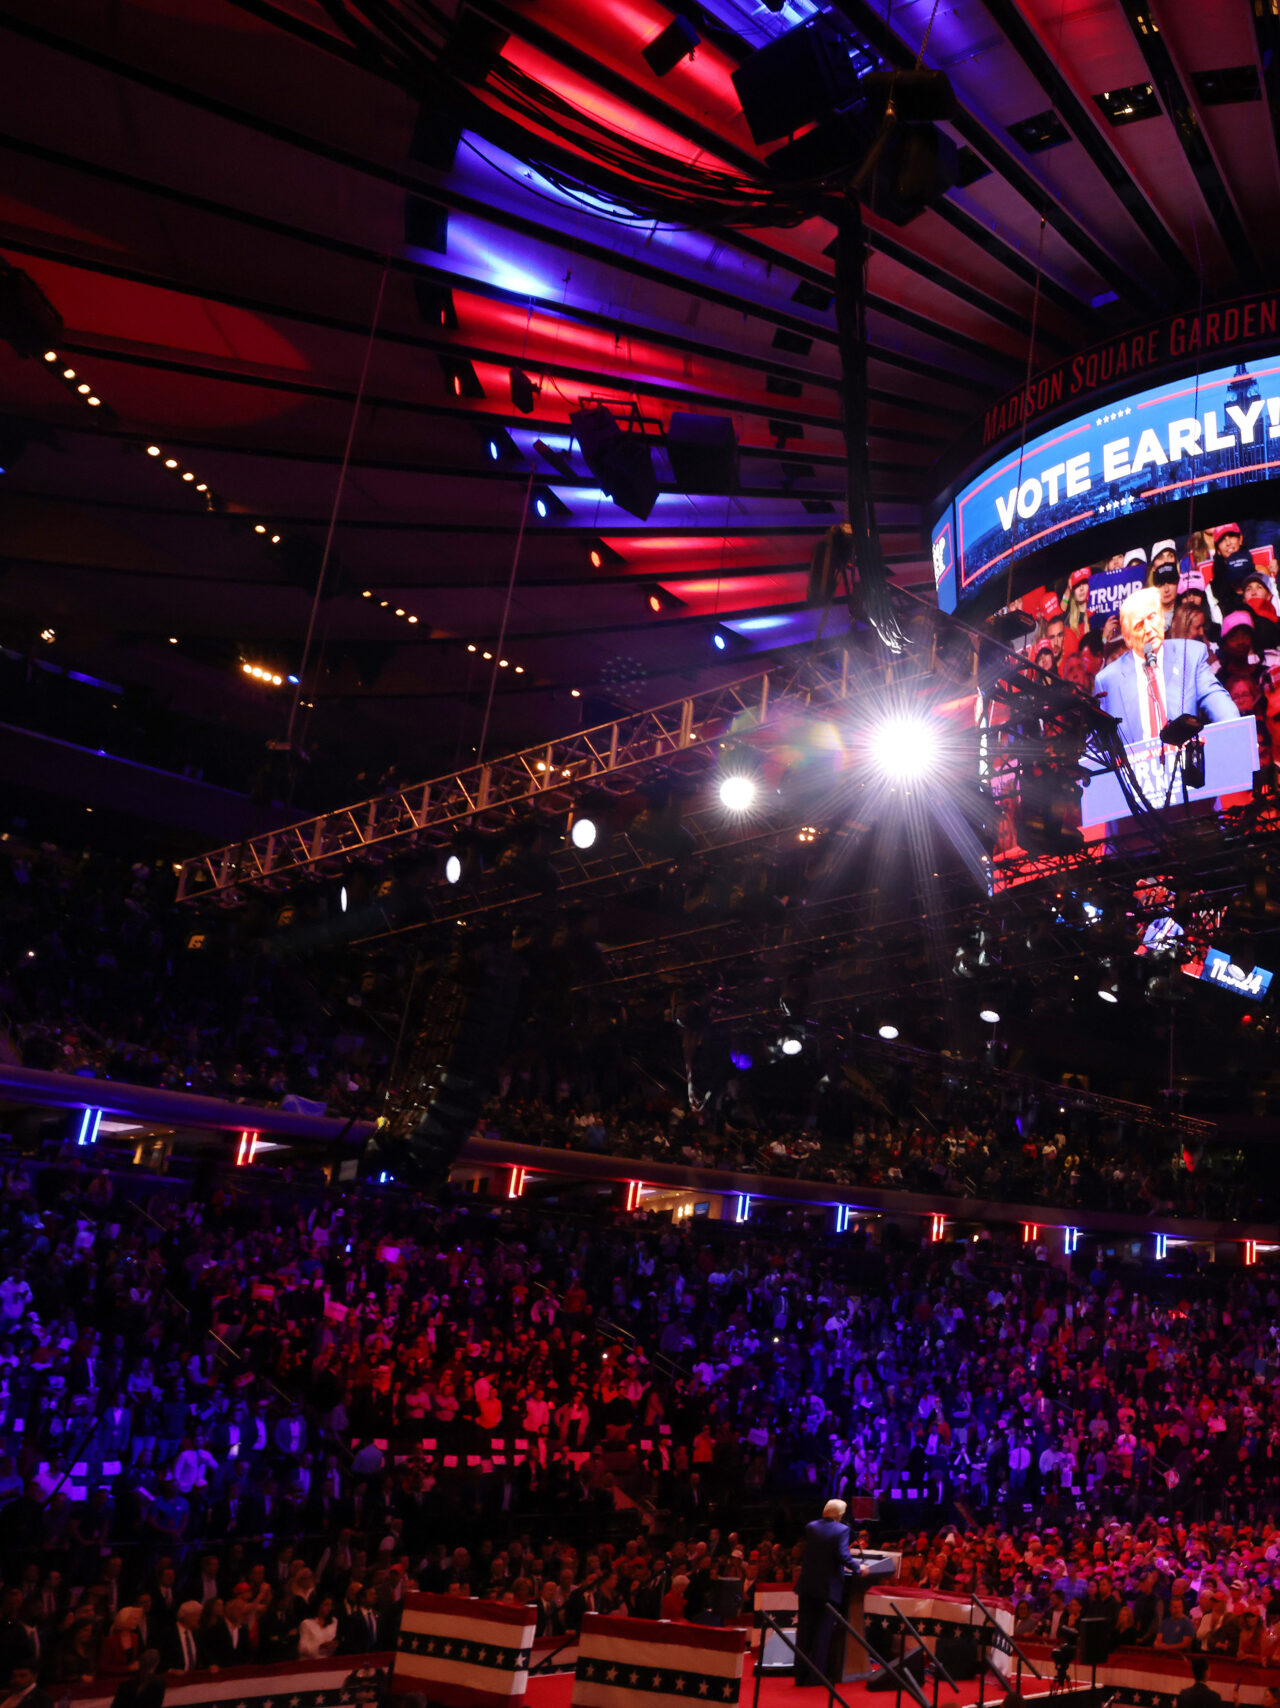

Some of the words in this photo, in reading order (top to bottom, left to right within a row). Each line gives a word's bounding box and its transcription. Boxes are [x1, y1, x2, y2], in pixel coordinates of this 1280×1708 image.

[984, 367, 1062, 444] MADISON
[1071, 330, 1159, 393] SQUARE
[1170, 300, 1276, 356] GARDEN
[995, 452, 1091, 531] VOTE
[1090, 580, 1143, 605] TRUMP
